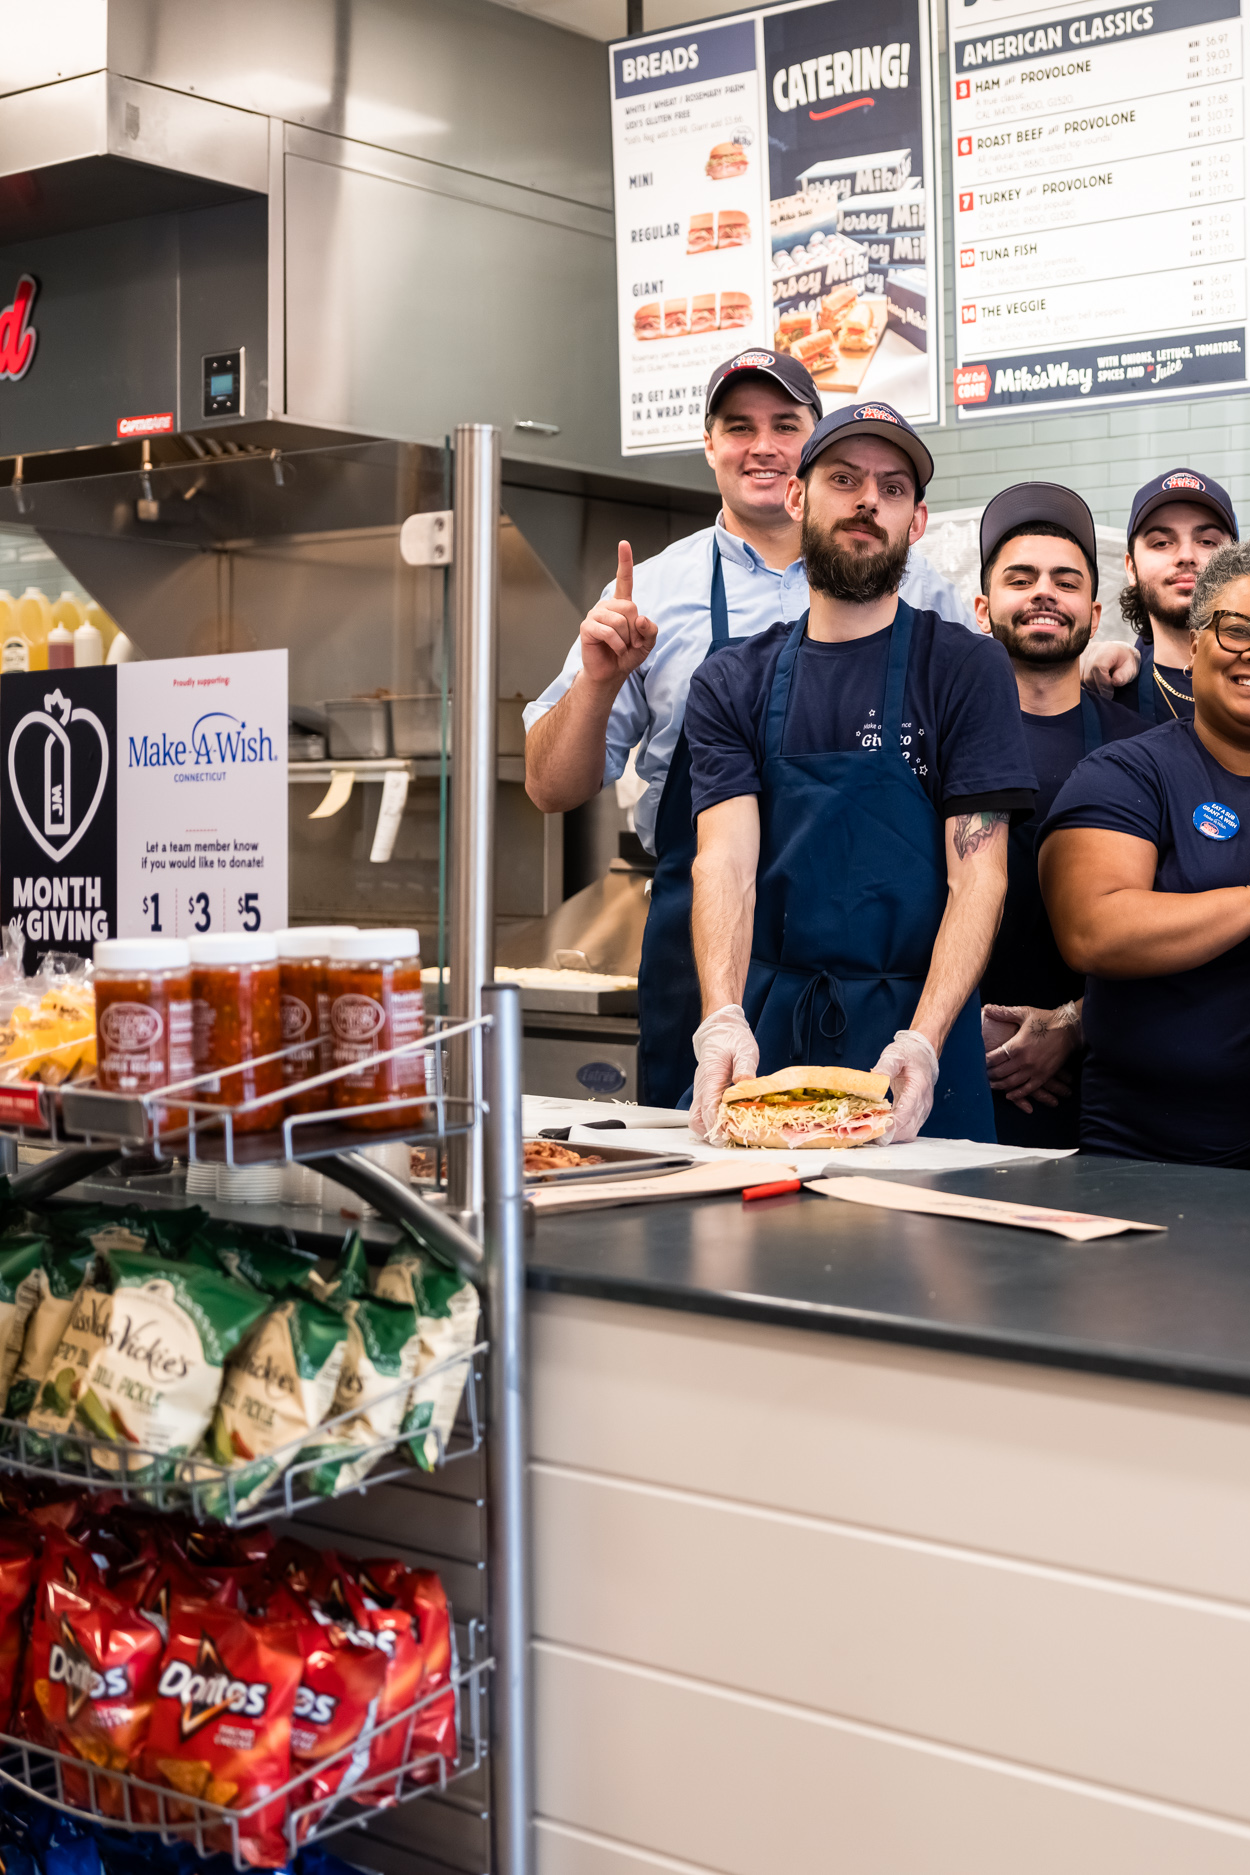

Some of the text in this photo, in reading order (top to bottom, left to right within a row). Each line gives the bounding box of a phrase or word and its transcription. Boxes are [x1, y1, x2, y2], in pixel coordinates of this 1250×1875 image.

[962, 6, 1154, 68] AMERICAN CLASSICS
[622, 43, 700, 84] BREADS
[975, 77, 1001, 93] HAM
[1020, 59, 1092, 85] PROVOLONE
[772, 42, 911, 113] CATERING!
[977, 132, 1012, 150] ROAST
[1016, 127, 1044, 143] BEEF
[1064, 110, 1136, 135] PROVOLONE
[629, 172, 654, 189] MINI
[979, 187, 1022, 206] TURKEY
[1042, 172, 1114, 196] PROVOLONE
[631, 223, 680, 244] REGULAR
[960, 242, 1038, 267] 10 TUNA FISH
[632, 280, 665, 297] GIANT
[981, 305, 1002, 319] THE
[1006, 298, 1047, 315] VEGGIE
[1096, 340, 1242, 370] WITH ONIONS, LETTUCE, TOMATOES,
[1097, 365, 1146, 383] SPICES AND
[1151, 359, 1184, 384] Juice
[632, 387, 687, 405] OR GET ANY
[957, 383, 987, 399] COME
[632, 403, 701, 421] IN A WRAP OR
[173, 676, 196, 688] Proudly
[173, 771, 227, 783] CONNECTICUT
[1202, 804, 1221, 818] GRANT
[1223, 817, 1238, 829] WISH
[1211, 803, 1222, 812] EAT
[1225, 811, 1236, 821] SUB
[146, 840, 159, 853] Let
[169, 842, 192, 853] team
[194, 839, 231, 852] member
[233, 838, 259, 852] know
[141, 855, 264, 873] if you would like to donate!
[13, 876, 102, 908] MONTH
[142, 892, 163, 933] $1
[188, 891, 212, 933] $3
[237, 892, 262, 933] $5
[26, 909, 109, 942] GIVING
[48, 1641, 130, 1700] Doritos
[157, 1658, 271, 1719] Doritos
